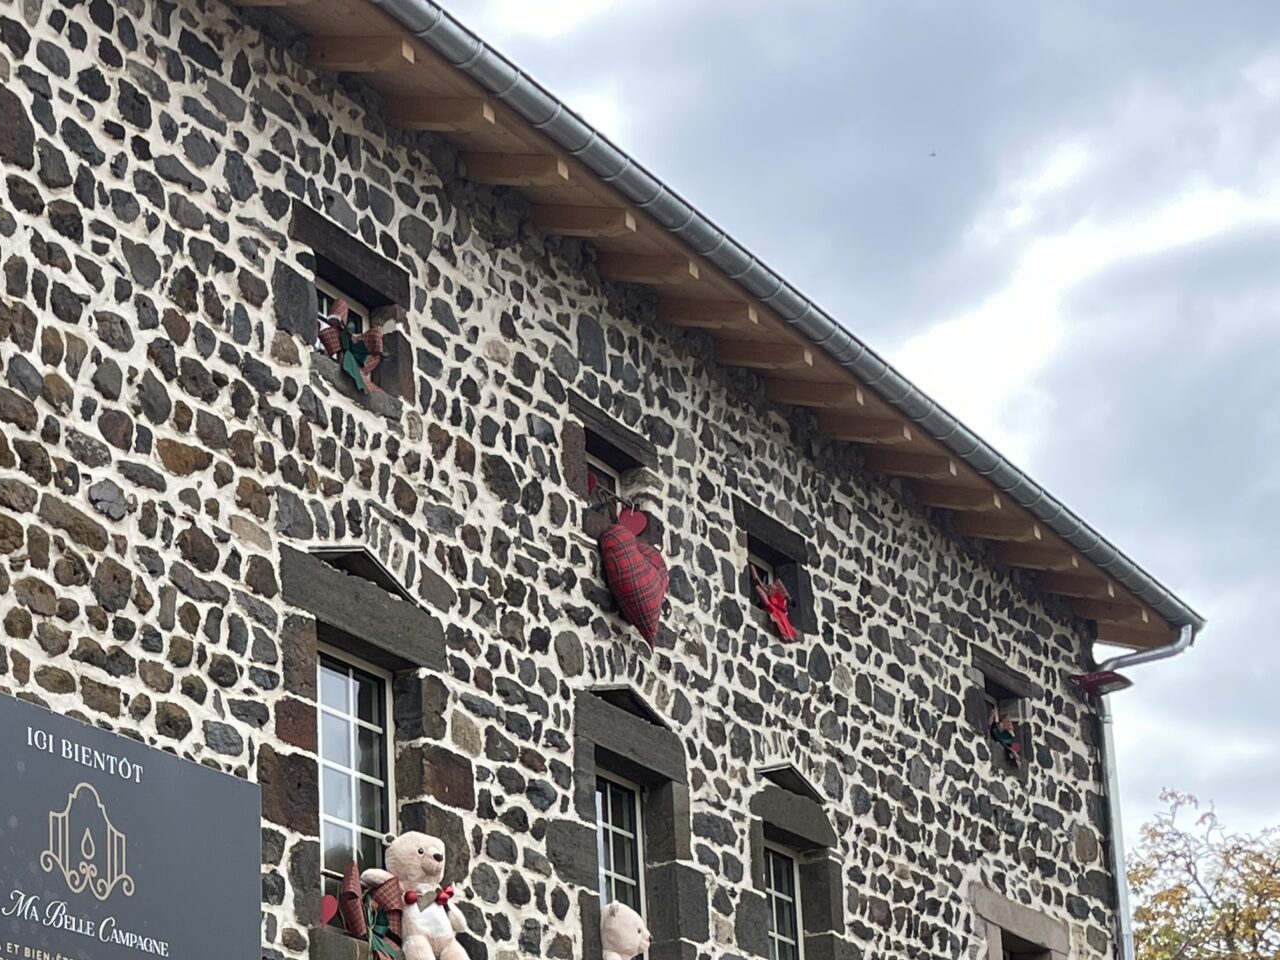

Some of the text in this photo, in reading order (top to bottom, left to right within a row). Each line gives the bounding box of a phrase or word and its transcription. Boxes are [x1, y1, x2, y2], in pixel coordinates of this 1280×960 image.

[27, 726, 144, 784] ICI BIENTÔT
[6, 942, 20, 955] ET
